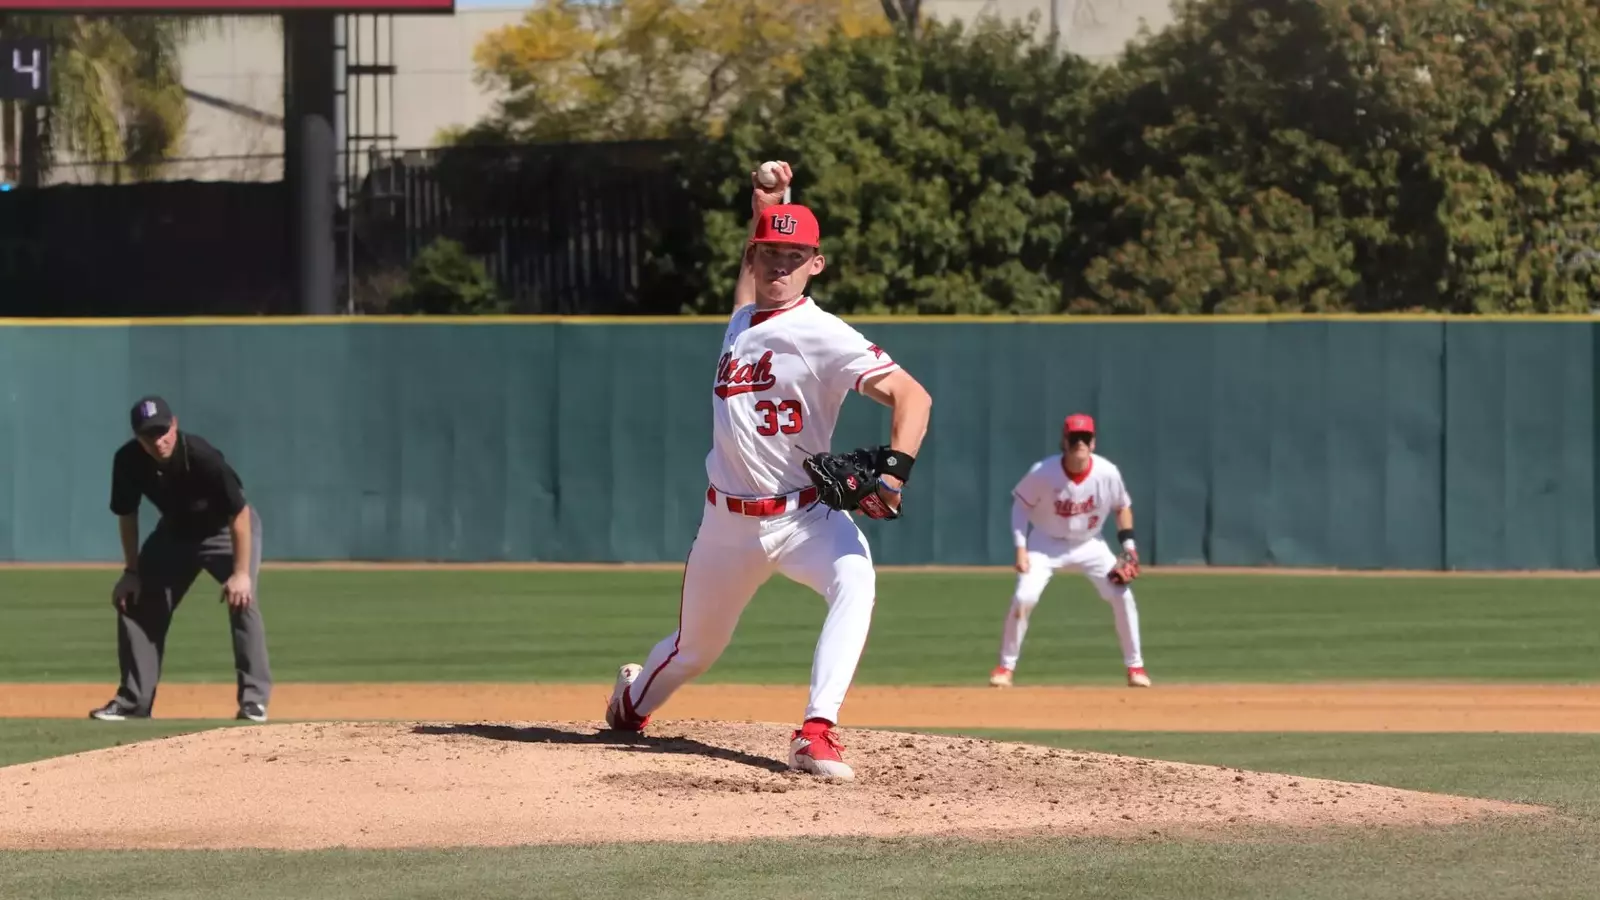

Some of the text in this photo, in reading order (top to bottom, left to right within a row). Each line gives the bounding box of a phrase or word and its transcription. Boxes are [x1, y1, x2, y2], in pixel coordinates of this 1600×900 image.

[12, 48, 41, 90] 4
[715, 350, 776, 392] Utah
[755, 400, 803, 436] 33
